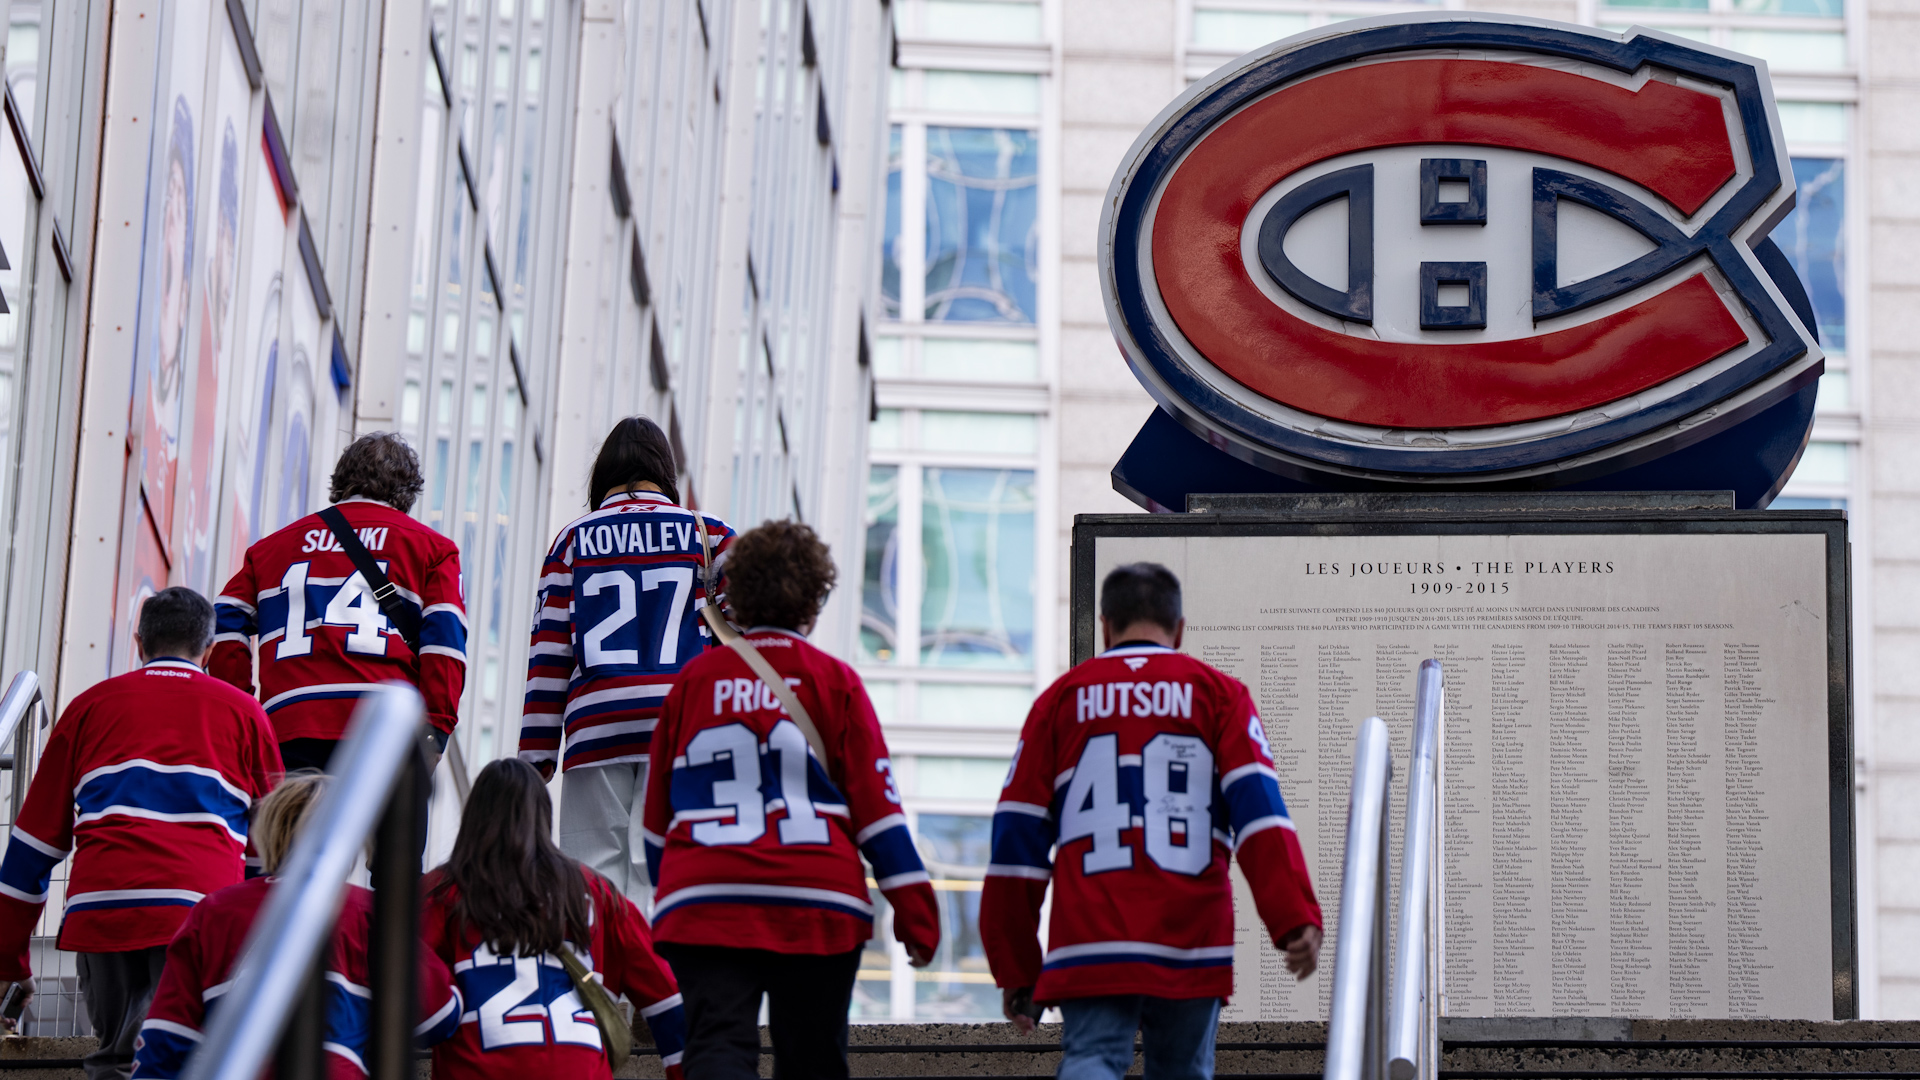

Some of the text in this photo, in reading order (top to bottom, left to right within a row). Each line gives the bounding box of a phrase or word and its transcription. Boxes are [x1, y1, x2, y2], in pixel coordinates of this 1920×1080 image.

[579, 522, 692, 556] KOVALEV
[1306, 562, 1614, 576] LES JOUEURS THE PLAYERS
[1412, 582, 1508, 594] 1909-2015
[276, 561, 389, 661] 14
[582, 566, 693, 668] 27
[1446, 605, 1474, 613] DISPUTÉ
[1476, 613, 1513, 622] PREMIÈRES
[1553, 613, 1584, 623] L'ÉQUIPE.
[746, 637, 794, 649] eebok
[146, 669, 192, 679] Reebok
[1077, 682, 1193, 722] HUTSON
[687, 719, 830, 846] 31
[1060, 732, 1214, 877] 48
[472, 940, 604, 1054] 22
